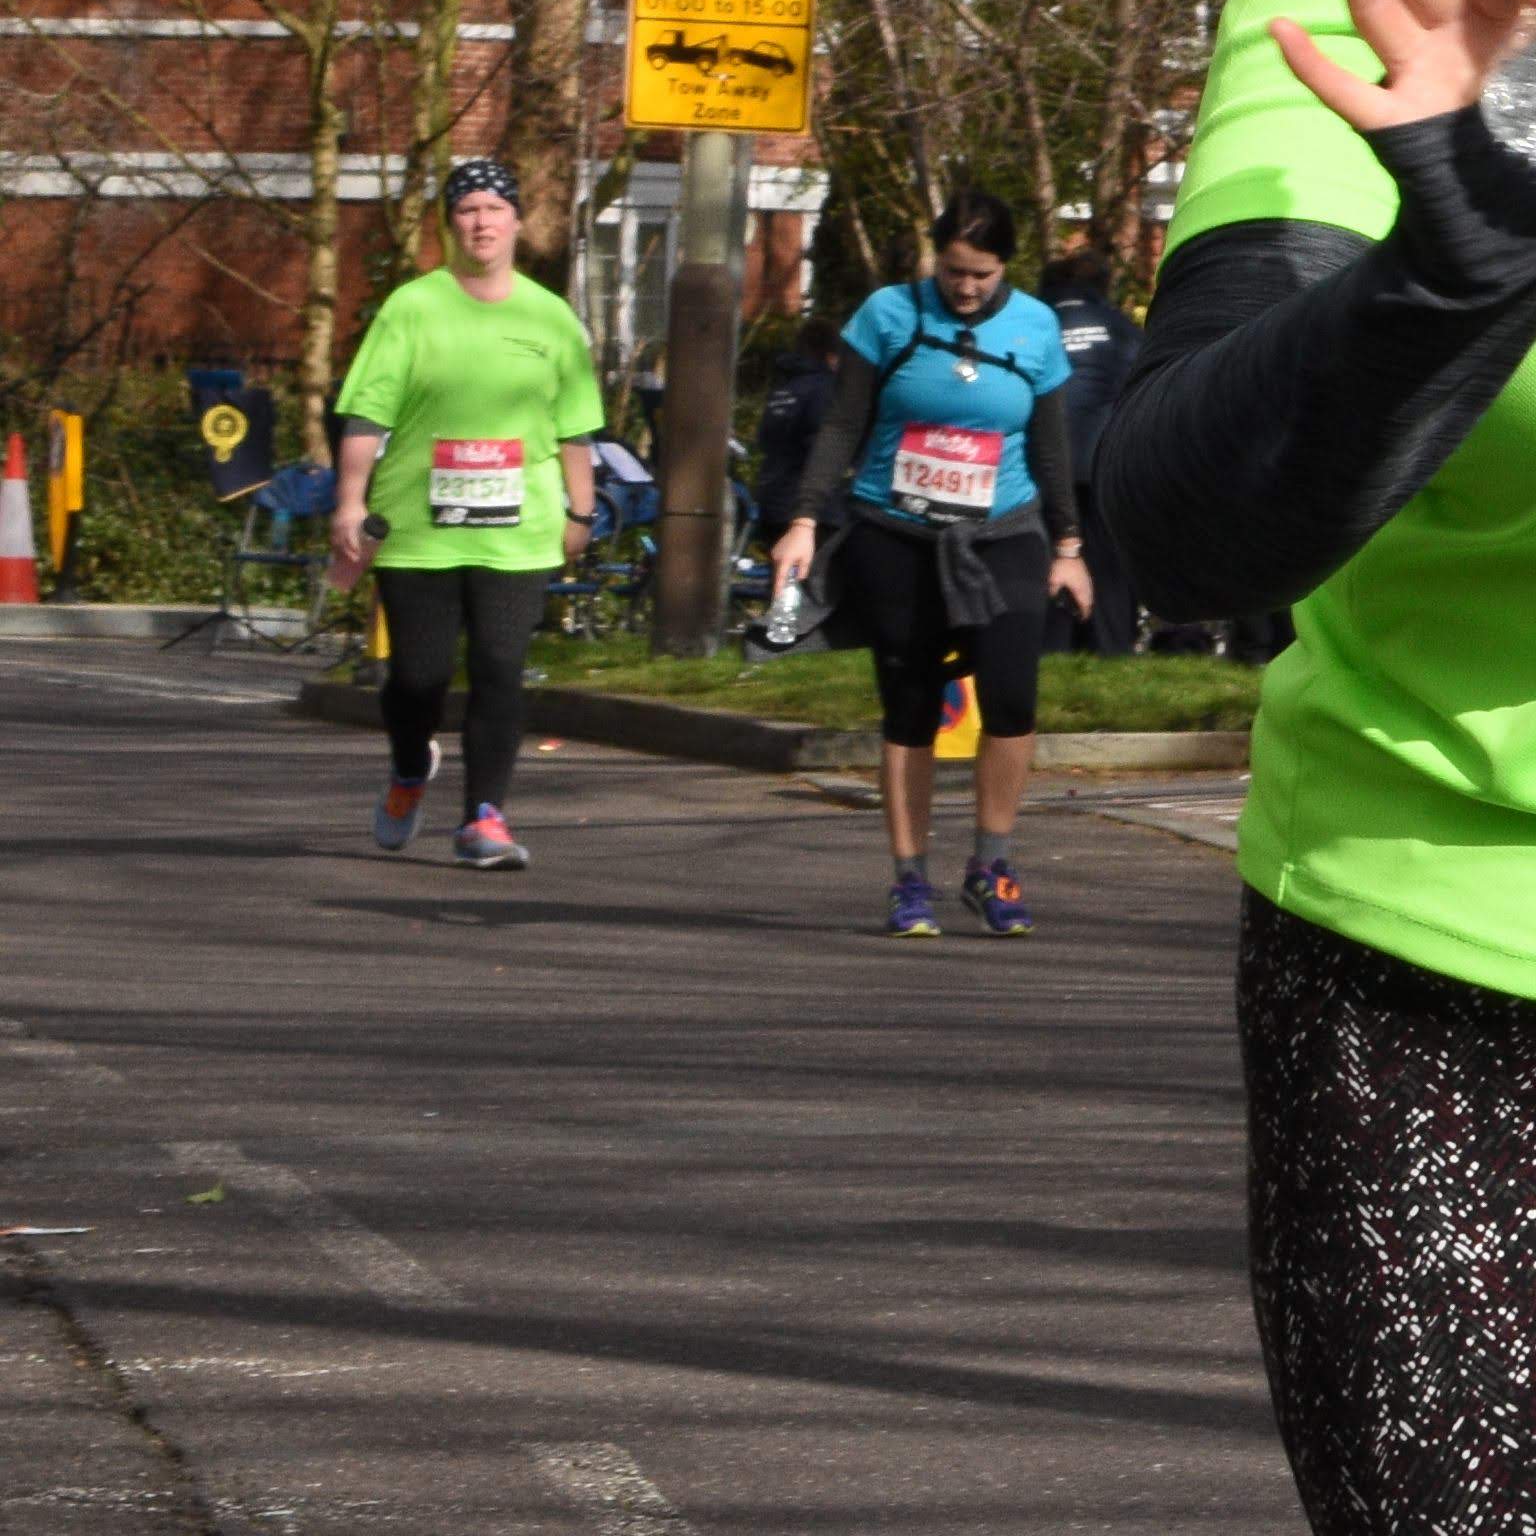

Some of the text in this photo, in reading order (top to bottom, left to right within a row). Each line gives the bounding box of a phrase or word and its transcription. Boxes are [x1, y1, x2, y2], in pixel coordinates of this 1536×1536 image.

[714, 0, 733, 14] to
[668, 77, 706, 96] Tow
[694, 102, 741, 120] Zone
